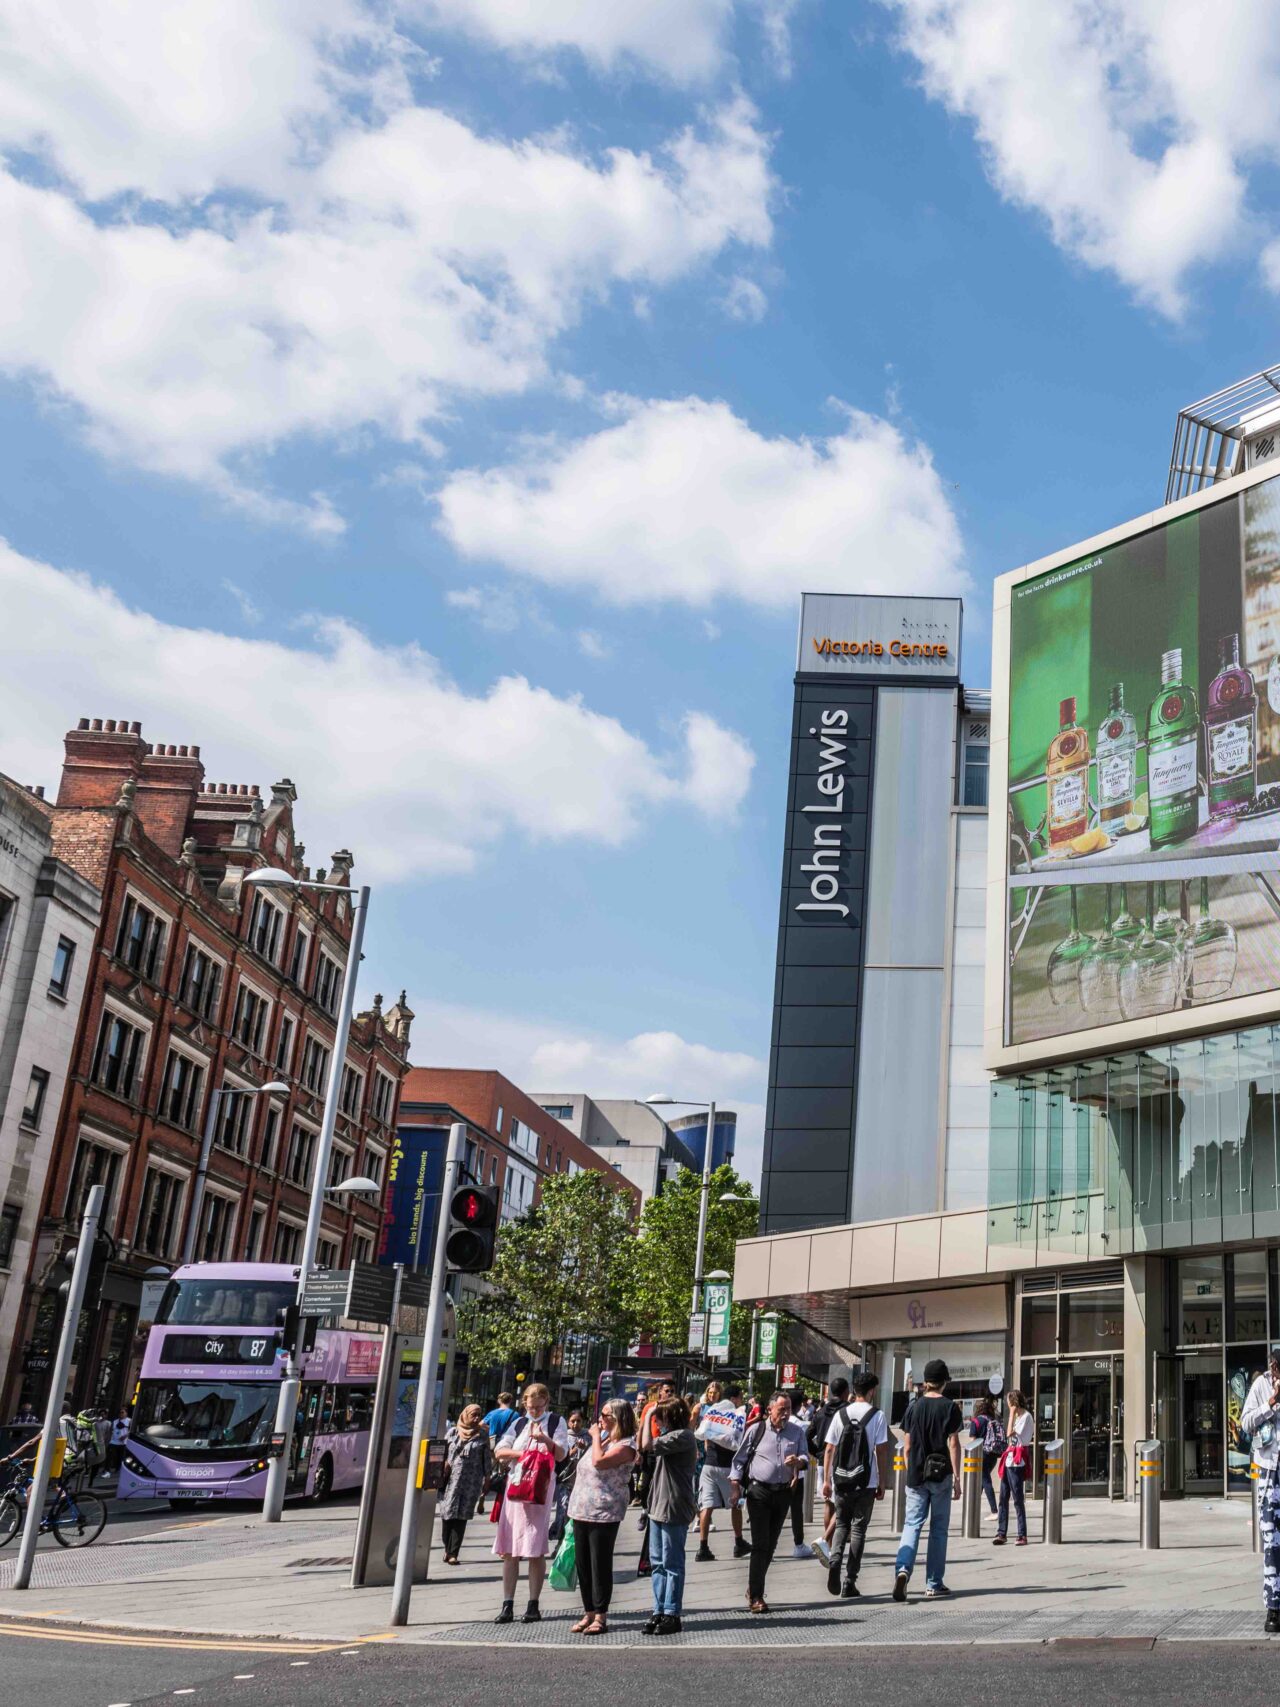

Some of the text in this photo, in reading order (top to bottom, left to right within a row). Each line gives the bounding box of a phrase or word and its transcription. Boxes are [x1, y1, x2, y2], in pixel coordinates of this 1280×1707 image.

[1044, 557, 1103, 587] drinkaware.co.uk
[812, 637, 948, 657] Victoria Centre
[1217, 747, 1245, 762] ROYALE
[1152, 761, 1193, 780] Tanqueray
[795, 709, 850, 917] John Lewis
[416, 1150, 428, 1187] discounts
[708, 1287, 726, 1297] LET'S
[708, 1296, 725, 1307] GO
[762, 1330, 774, 1338] GO
[205, 1340, 267, 1357] City 87
[175, 1467, 214, 1478] Transport
